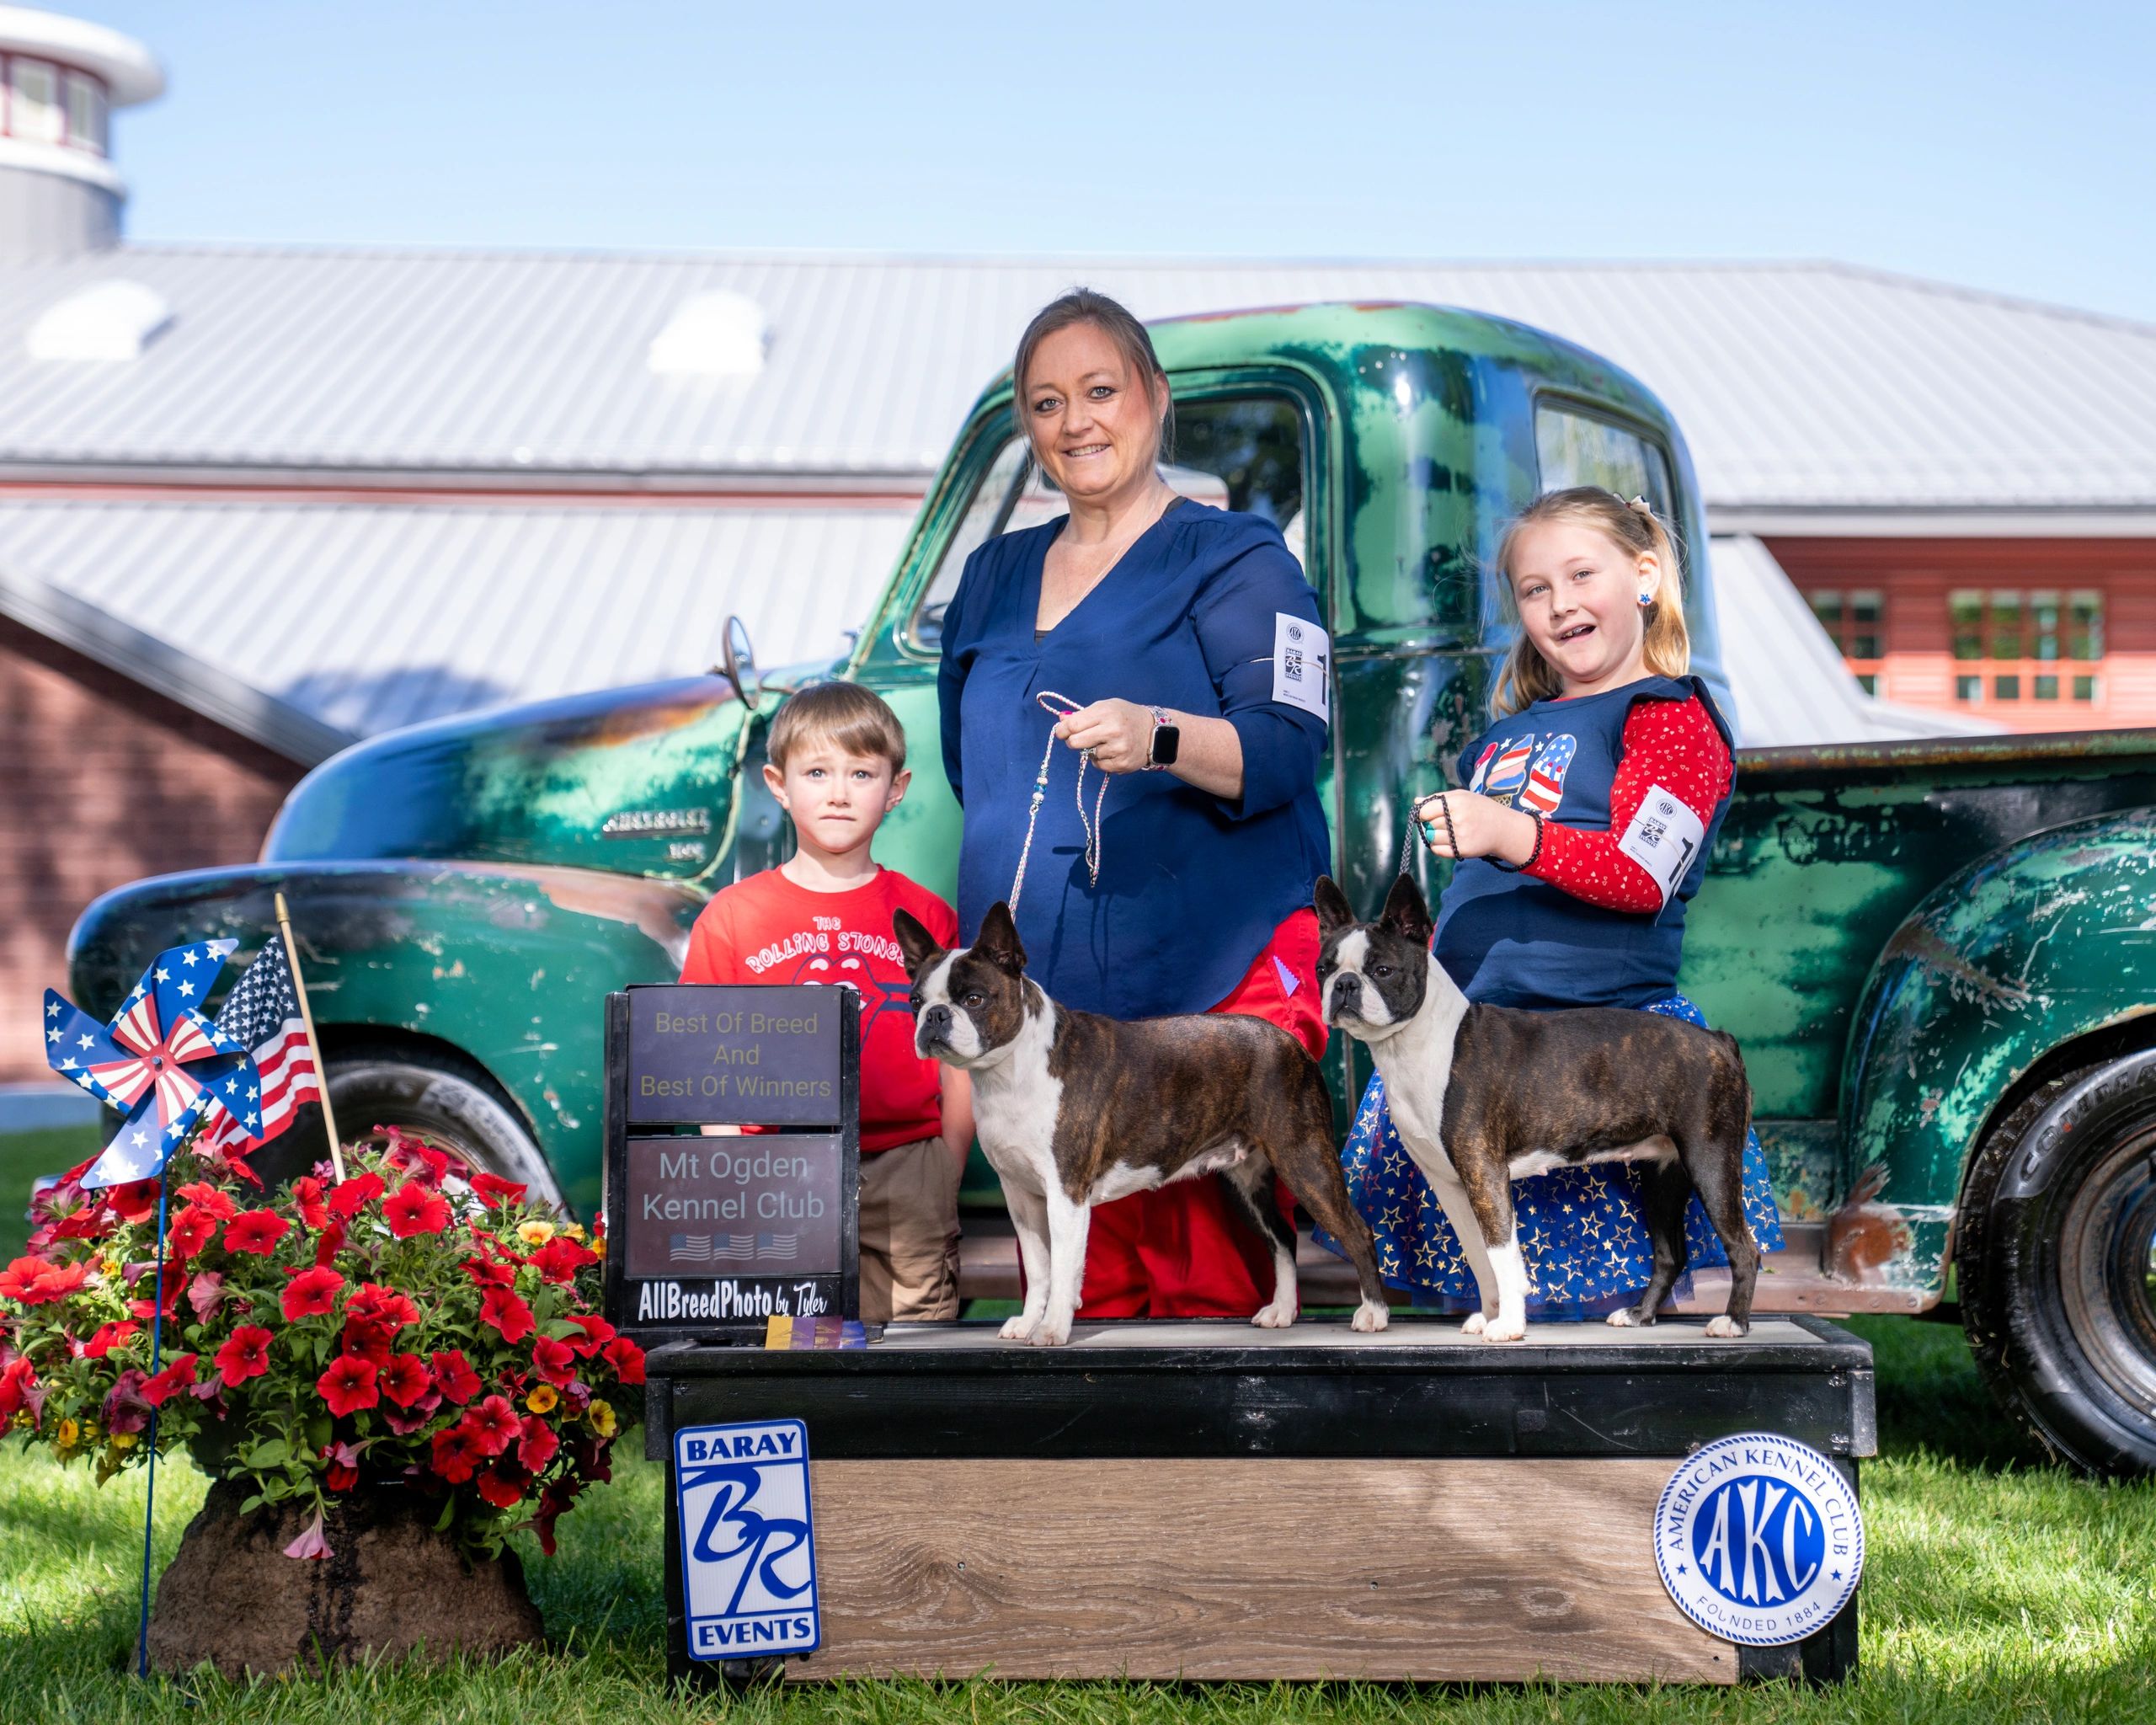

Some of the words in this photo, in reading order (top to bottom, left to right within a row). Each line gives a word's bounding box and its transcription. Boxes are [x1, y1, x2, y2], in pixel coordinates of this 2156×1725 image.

[813, 916, 841, 931] THE
[655, 1012, 707, 1033] Best
[716, 1012, 743, 1033] Of
[751, 1012, 818, 1033] Breed
[713, 1044, 760, 1065] And
[641, 1076, 693, 1097] Best
[701, 1075, 728, 1097] Of
[735, 1076, 831, 1097] Winners
[659, 1152, 700, 1179] Mt
[710, 1151, 808, 1184] Ogden
[643, 1193, 745, 1220] Kennel
[756, 1192, 825, 1219] Club
[638, 1279, 772, 1322] AllBreedPhoto
[776, 1285, 790, 1317] by
[793, 1282, 828, 1317] Tyler
[686, 1432, 797, 1462] BARAY
[1668, 1450, 1738, 1551] AMERICAN
[1745, 1449, 1828, 1497] KENNEL
[1825, 1498, 1849, 1556] CLUB
[1700, 1478, 1817, 1606] AKC
[1696, 1595, 1777, 1632] FOUNDED
[1785, 1601, 1822, 1627] 1884
[698, 1617, 811, 1647] EVENTS
